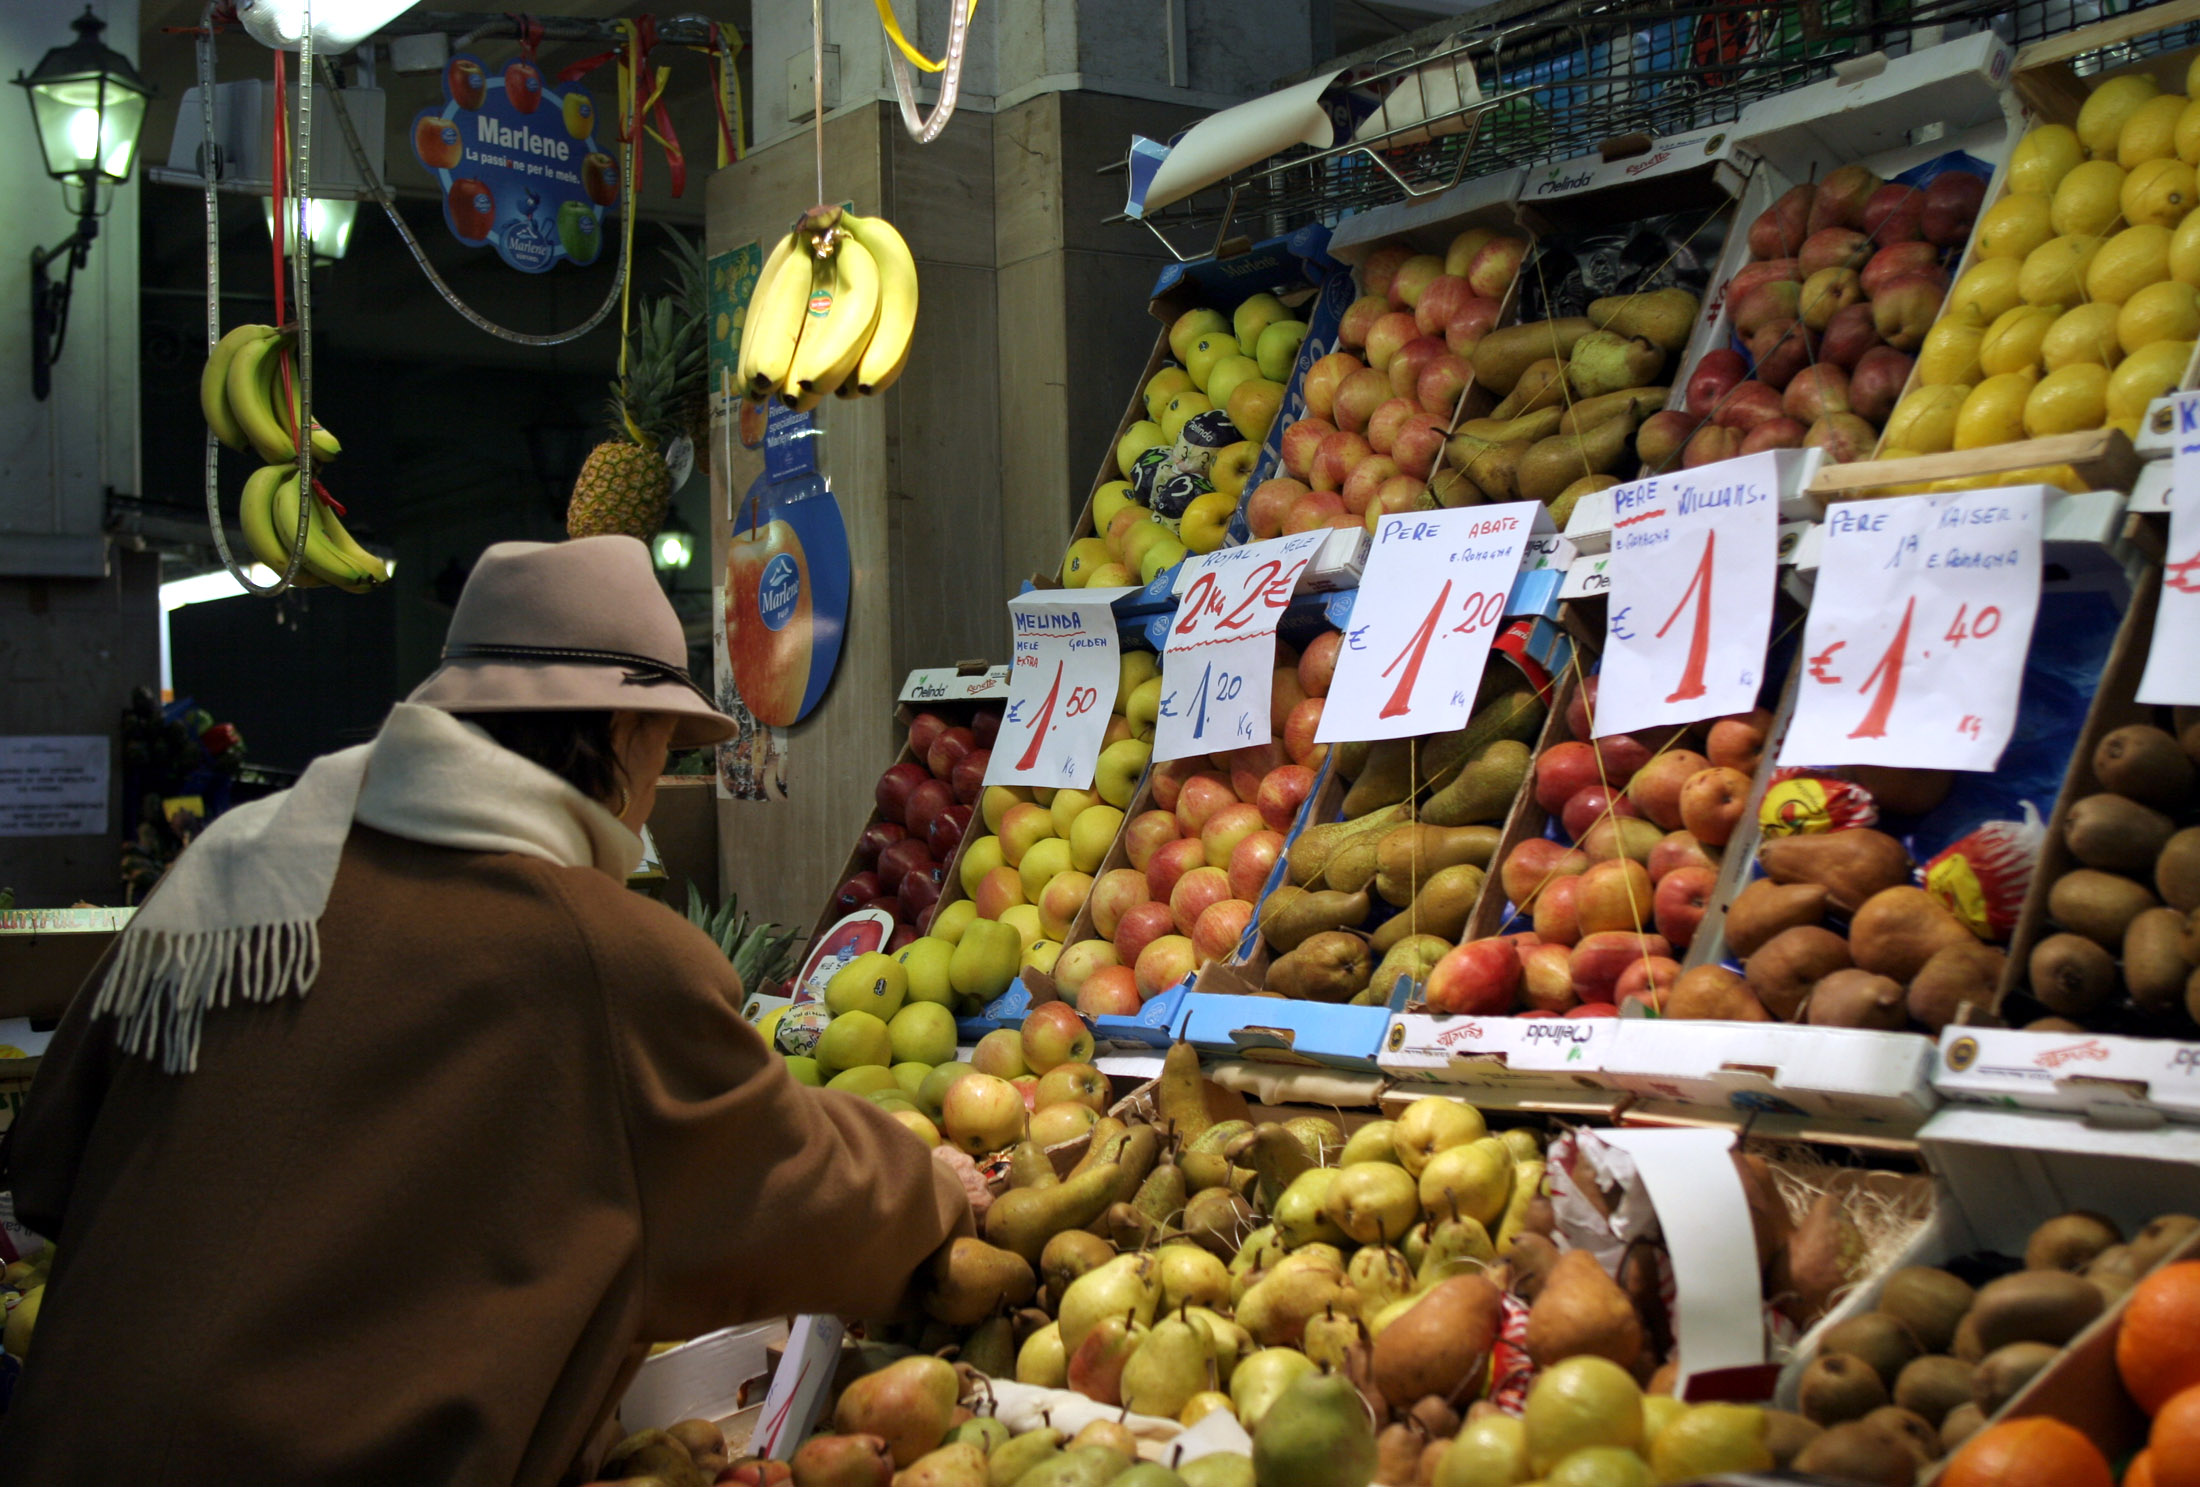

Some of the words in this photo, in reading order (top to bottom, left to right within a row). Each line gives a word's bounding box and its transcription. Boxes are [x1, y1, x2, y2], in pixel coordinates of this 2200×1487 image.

[477, 114, 570, 161] Marlene
[466, 148, 478, 161] La
[527, 164, 543, 176] per
[1538, 171, 1591, 195] Melinda
[1615, 482, 1658, 514] PERE
[1382, 520, 1441, 544] PERE
[1468, 517, 1520, 539] ABATE
[1829, 510, 1890, 537] PERE
[761, 582, 799, 613] Marlene
[1015, 611, 1081, 632] MELINDA
[1611, 606, 1636, 640] €
[1655, 528, 1714, 703] 1
[1017, 640, 1039, 651] MELE
[1348, 624, 1371, 650] €
[1808, 640, 1848, 684] €
[912, 683, 948, 699] Melinda
[1526, 1024, 1593, 1046] Melinda
